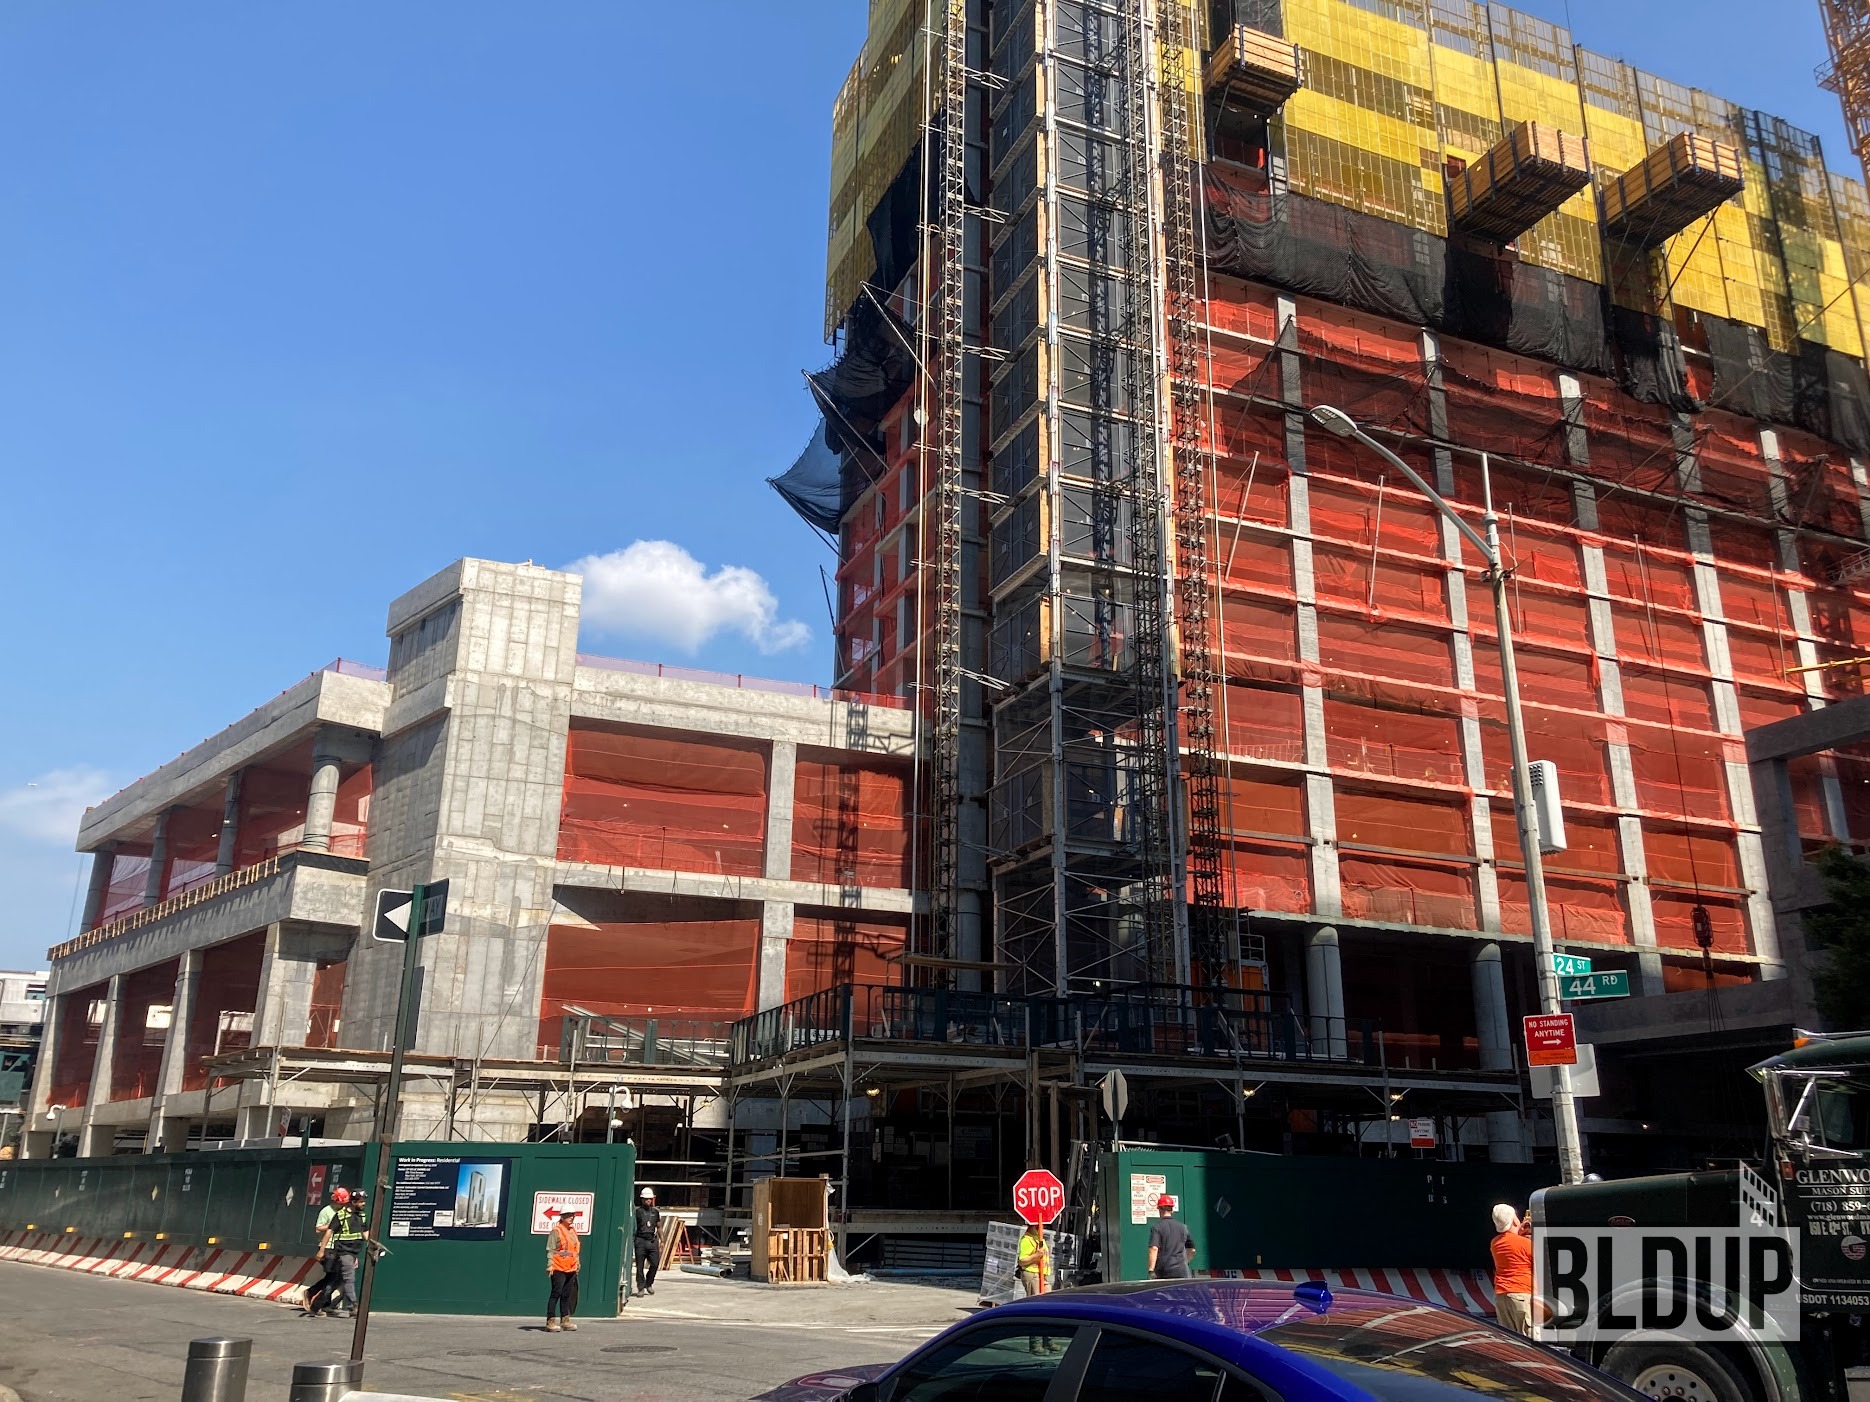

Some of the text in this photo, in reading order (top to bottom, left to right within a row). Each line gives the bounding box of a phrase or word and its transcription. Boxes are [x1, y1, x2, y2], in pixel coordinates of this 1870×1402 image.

[1556, 957, 1586, 975] 24 ST
[1569, 975, 1618, 996] 44 RD
[1540, 1019, 1569, 1028] STANDING
[1534, 1029, 1565, 1038] ANYTIME
[1017, 1186, 1060, 1208] STOP
[1811, 1186, 1847, 1195] MASON
[538, 1196, 590, 1205] SIDEWALK CLOSED
[1810, 1200, 1838, 1213] (718)
[1749, 1209, 1765, 1228] 4
[538, 1221, 550, 1230] USE
[1795, 1293, 1870, 1306] USDOT 1134053
